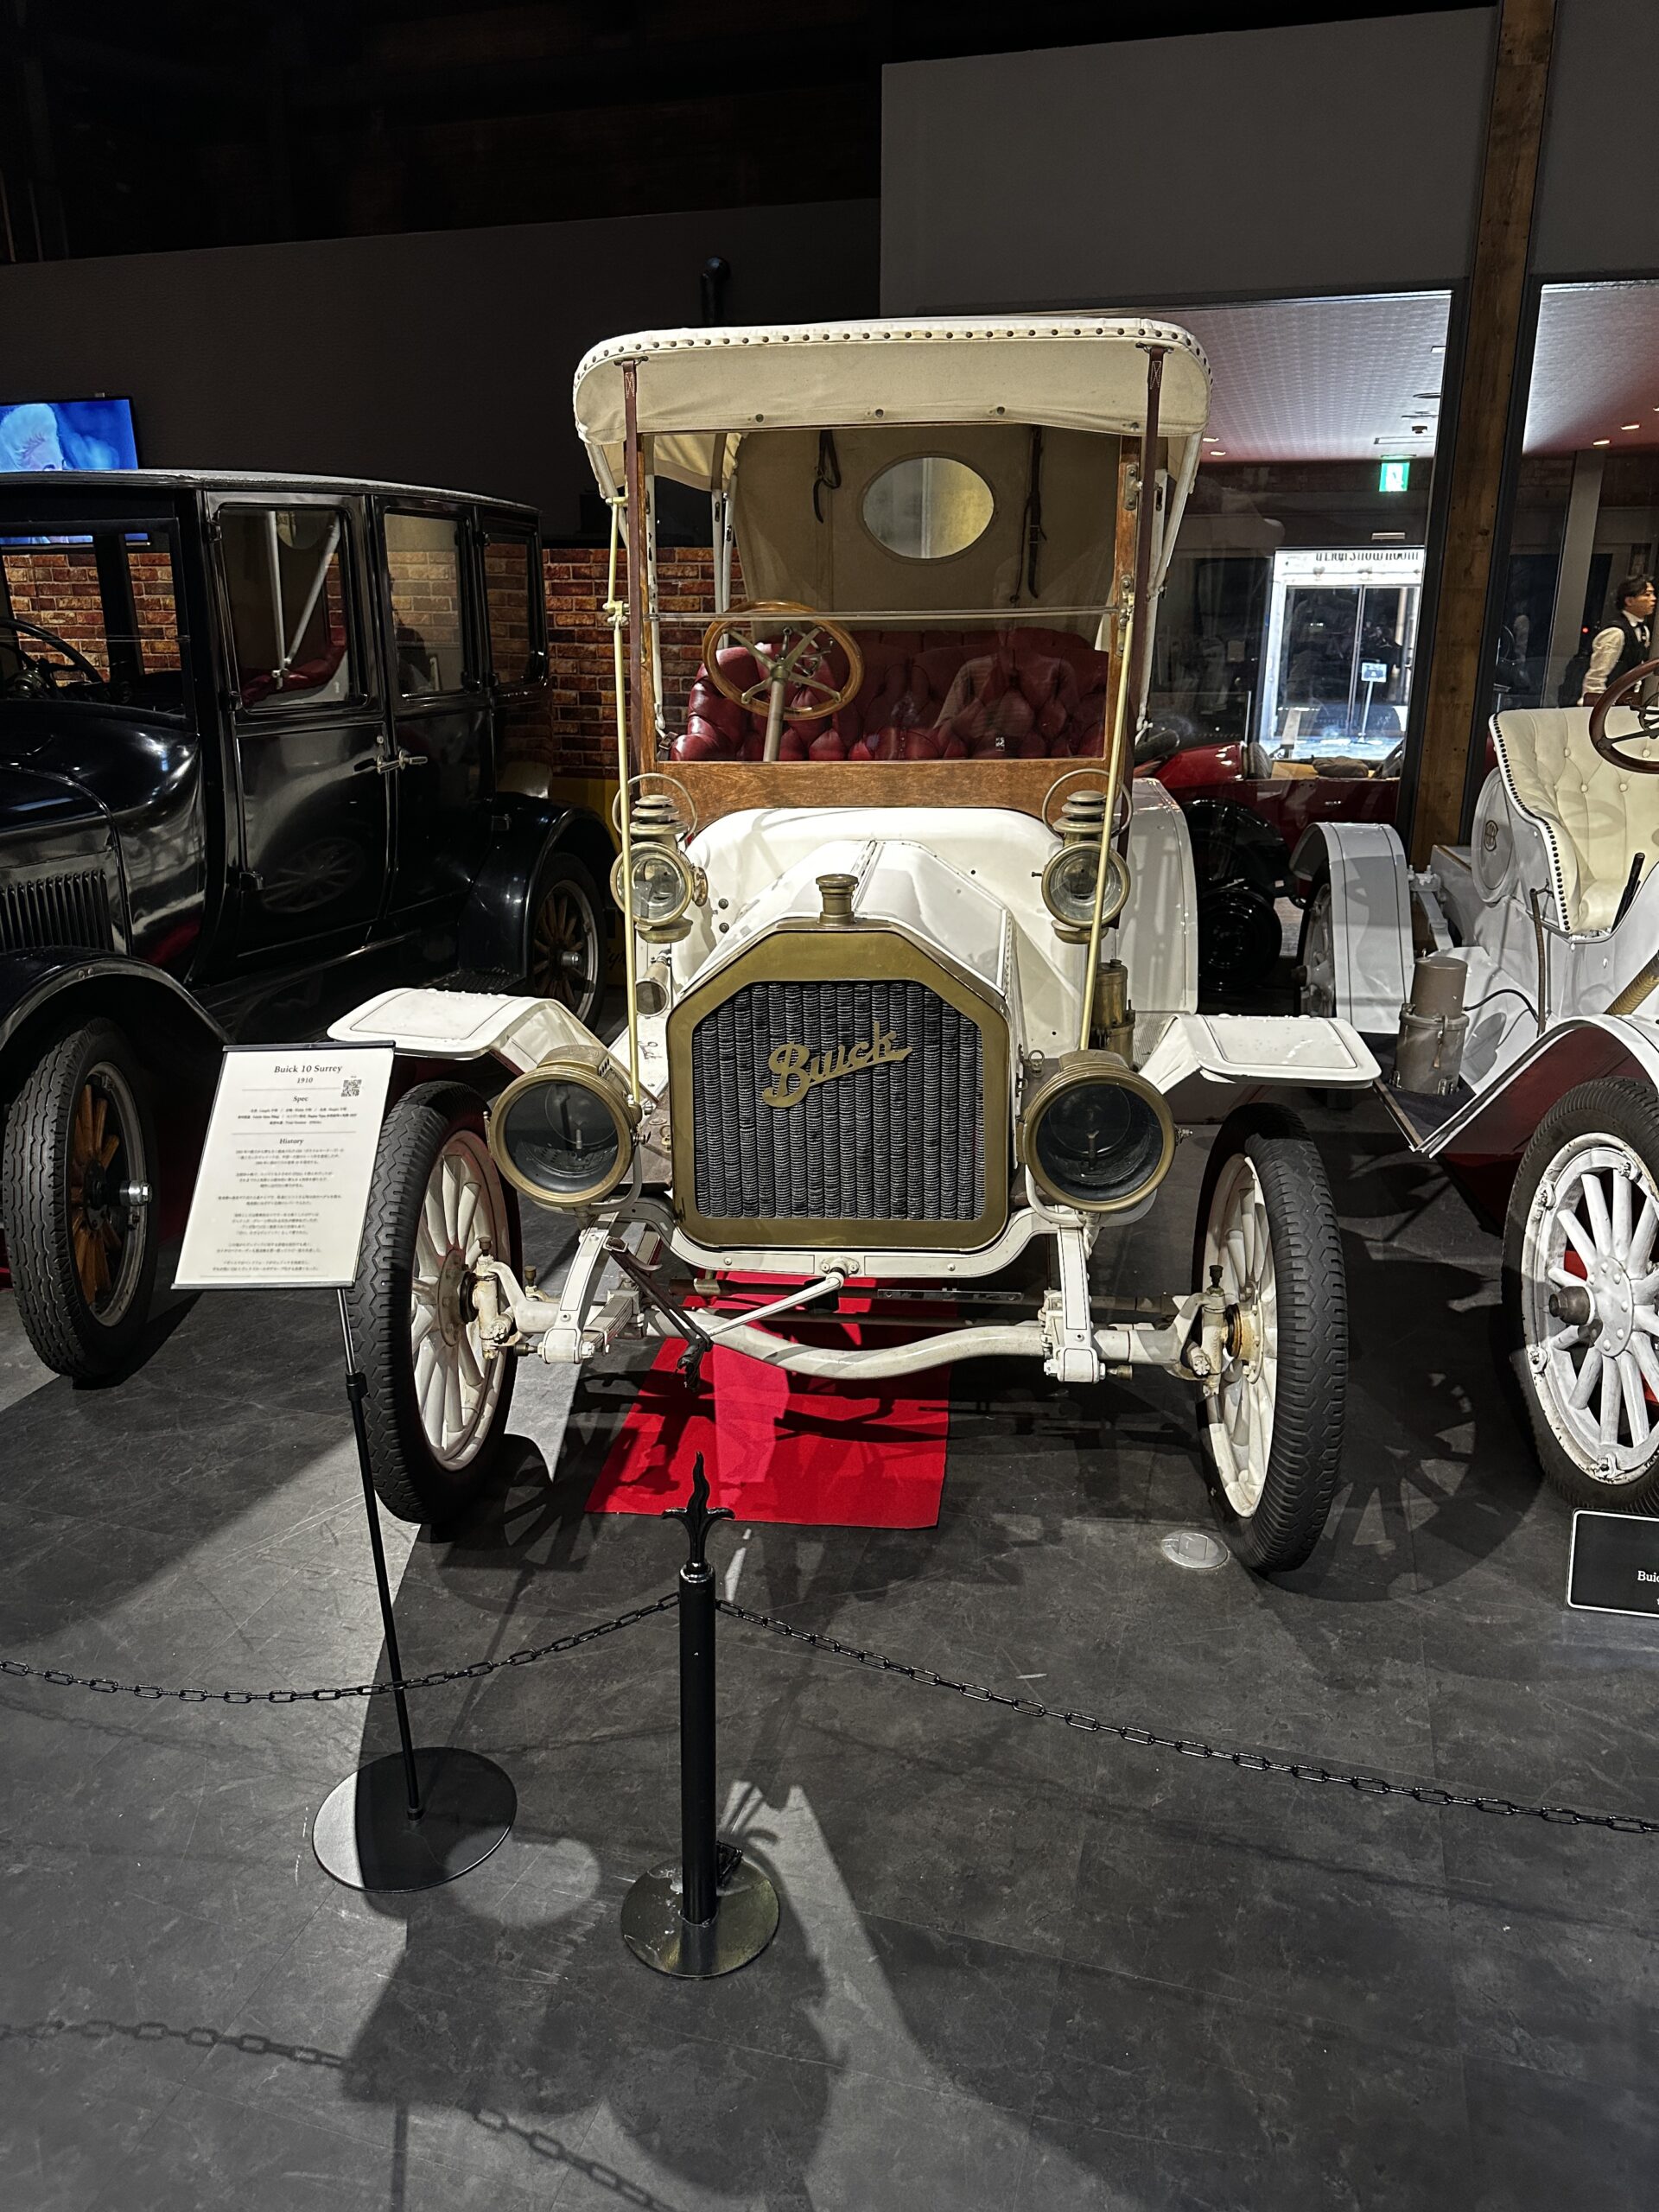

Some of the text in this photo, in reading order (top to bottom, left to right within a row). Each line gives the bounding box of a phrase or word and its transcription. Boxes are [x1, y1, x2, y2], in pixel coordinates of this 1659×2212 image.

[274, 1065, 298, 1073] Buick
[314, 1064, 343, 1074] Surrey
[762, 1020, 913, 1109] Buick
[279, 1137, 304, 1146] History
